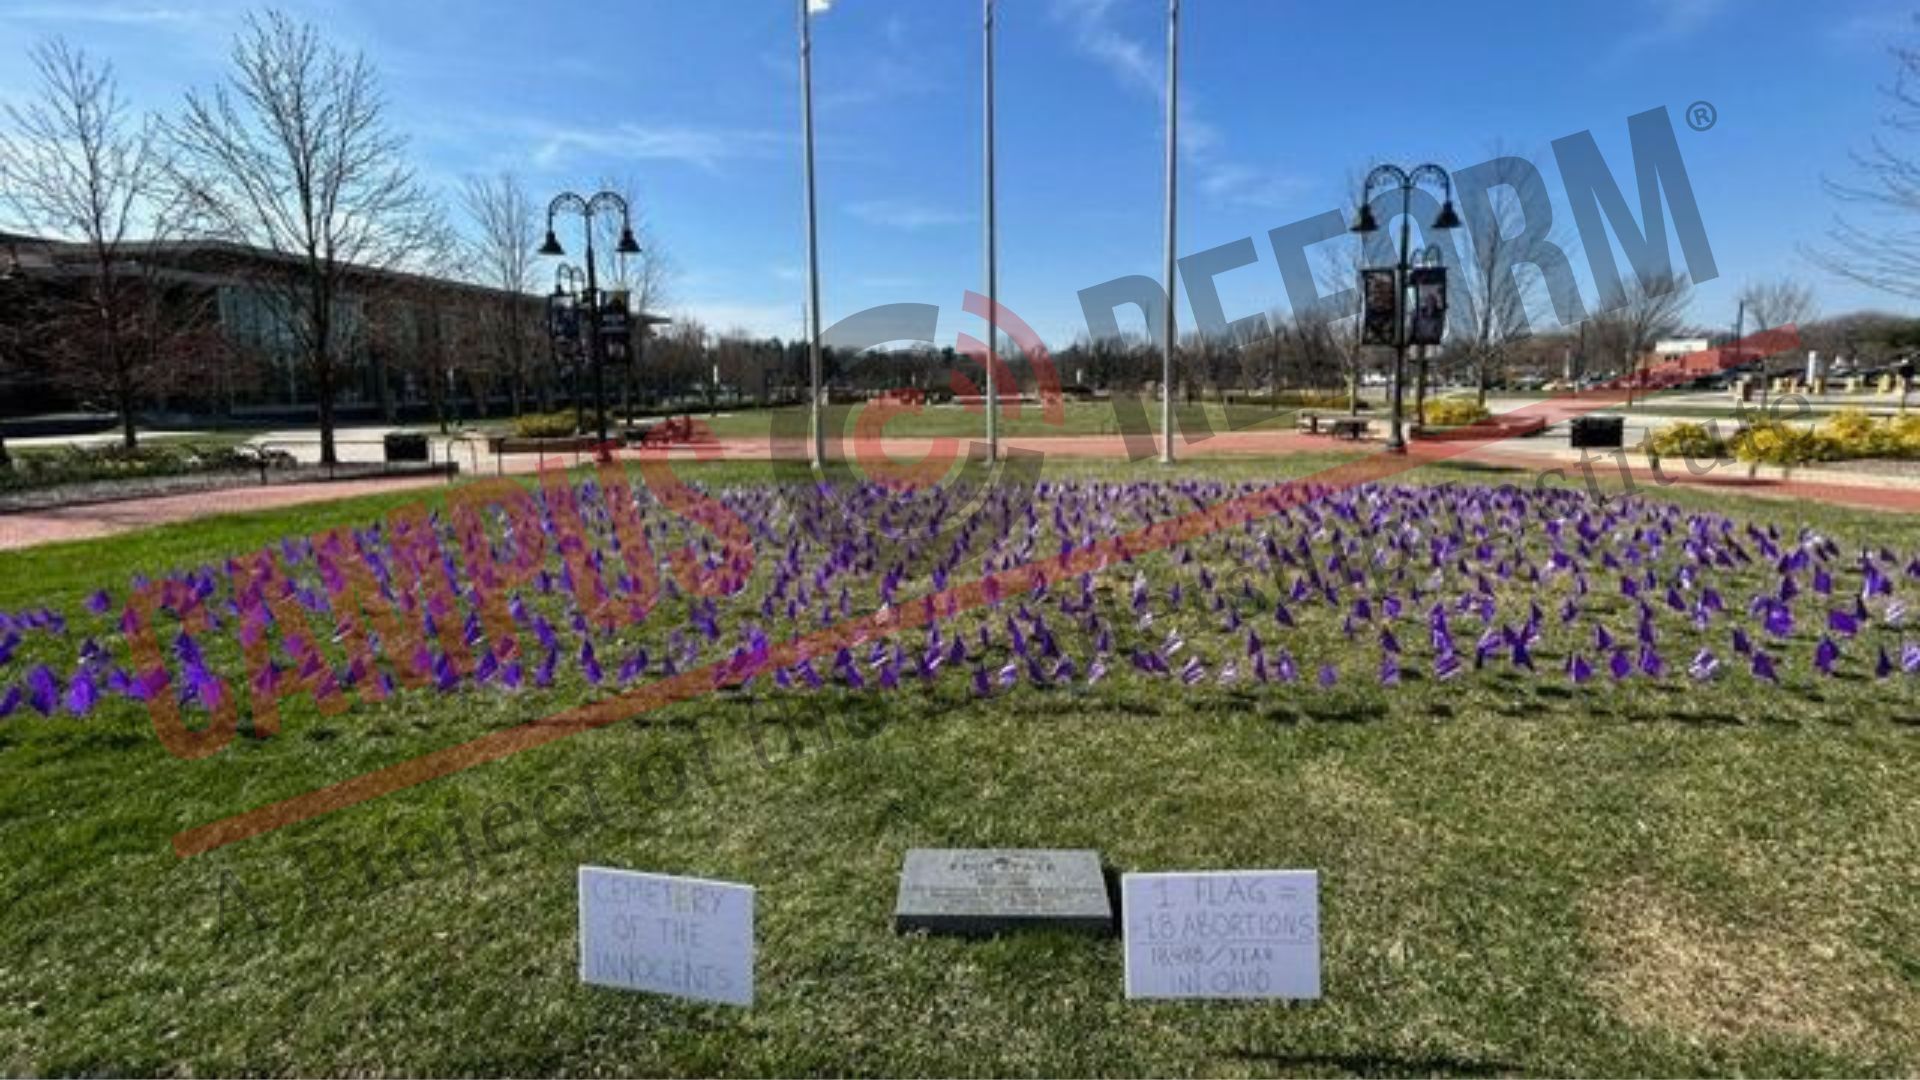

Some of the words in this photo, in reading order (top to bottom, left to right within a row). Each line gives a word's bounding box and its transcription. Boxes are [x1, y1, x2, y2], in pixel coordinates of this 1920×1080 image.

[594, 877, 724, 915] CEMETERY
[1195, 876, 1268, 907] FLAG
[612, 914, 642, 941] OF
[655, 918, 704, 949] THE
[1182, 911, 1315, 939] ABORTIONS
[595, 950, 735, 991] INNOCENTS
[1209, 969, 1270, 993] OHIO
